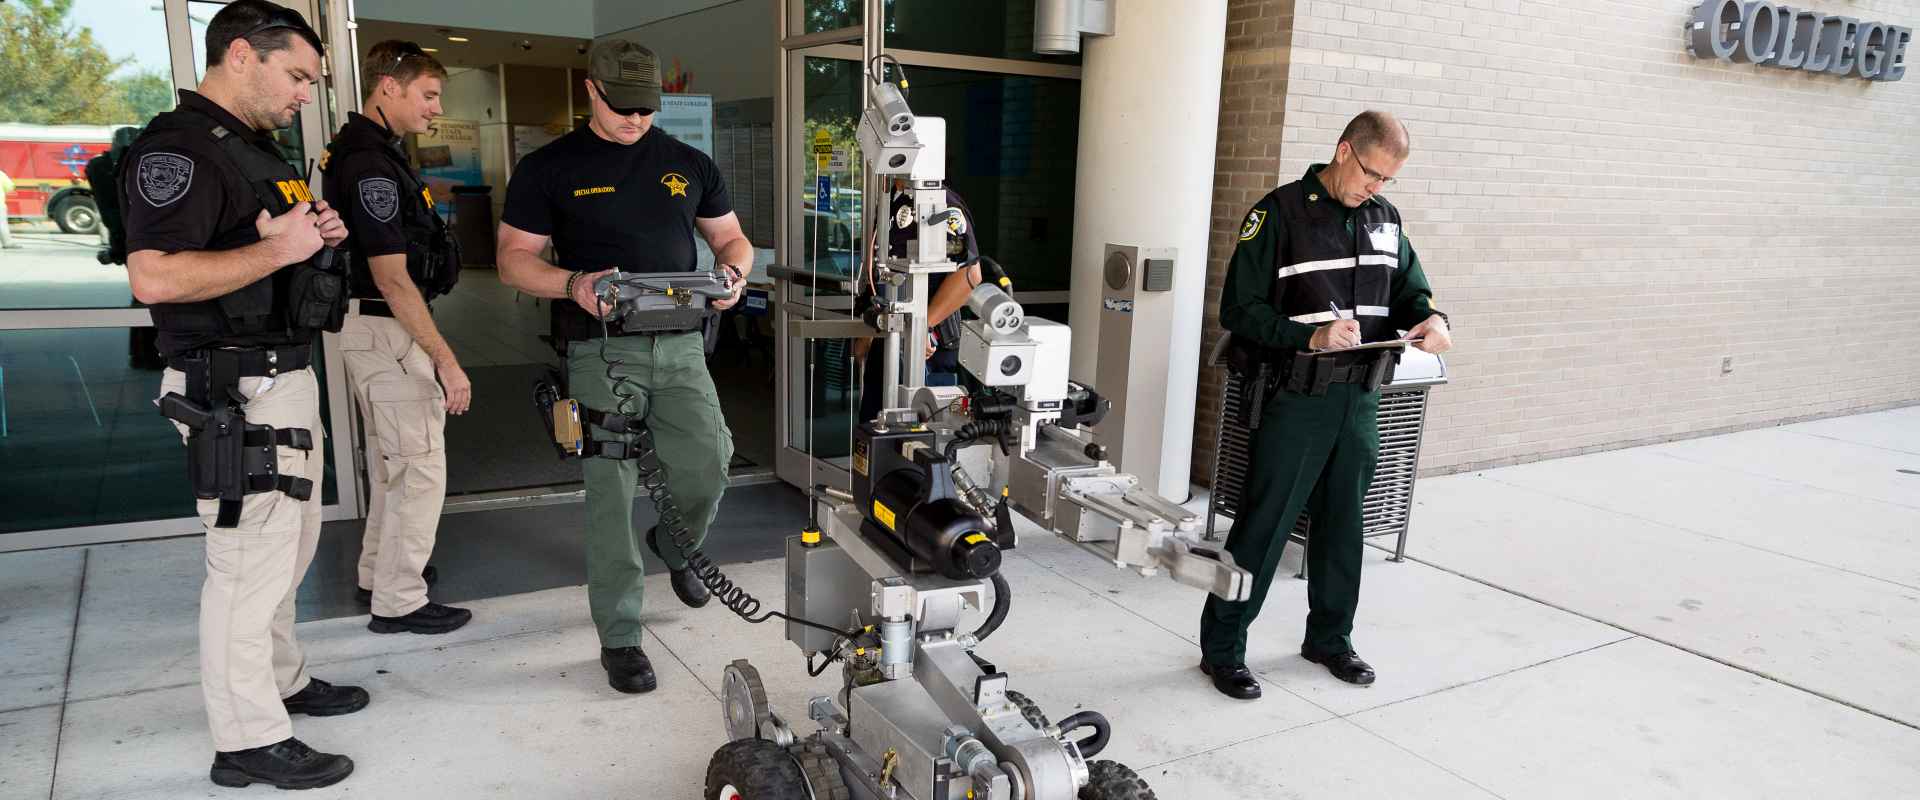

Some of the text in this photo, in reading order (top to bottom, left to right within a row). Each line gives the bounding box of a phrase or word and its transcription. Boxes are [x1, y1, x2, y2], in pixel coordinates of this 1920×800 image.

[1686, 0, 1912, 81] COLLEGE
[276, 179, 315, 204] POLI
[574, 186, 616, 197] SPECIAL OPERATIONS
